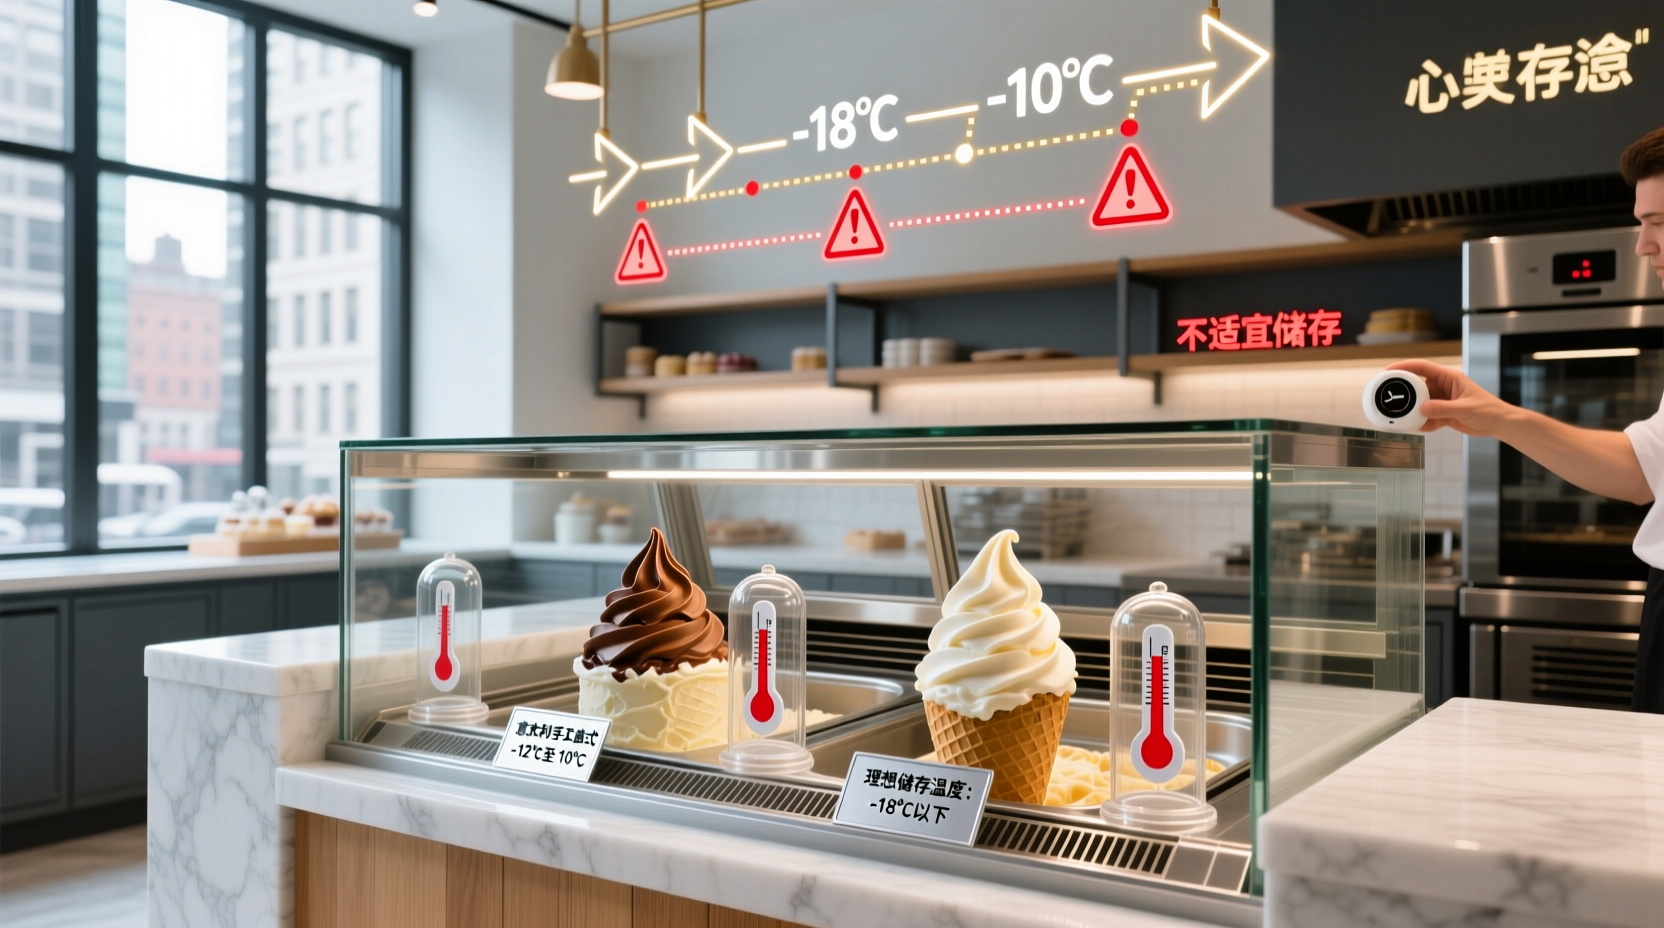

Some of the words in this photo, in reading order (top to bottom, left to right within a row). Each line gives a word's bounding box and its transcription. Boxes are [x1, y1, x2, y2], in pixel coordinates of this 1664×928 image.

[987, 53, 1114, 118] -10°C
[793, 94, 899, 152] -18°C
[1177, 309, 1342, 352] 不适宜储存
